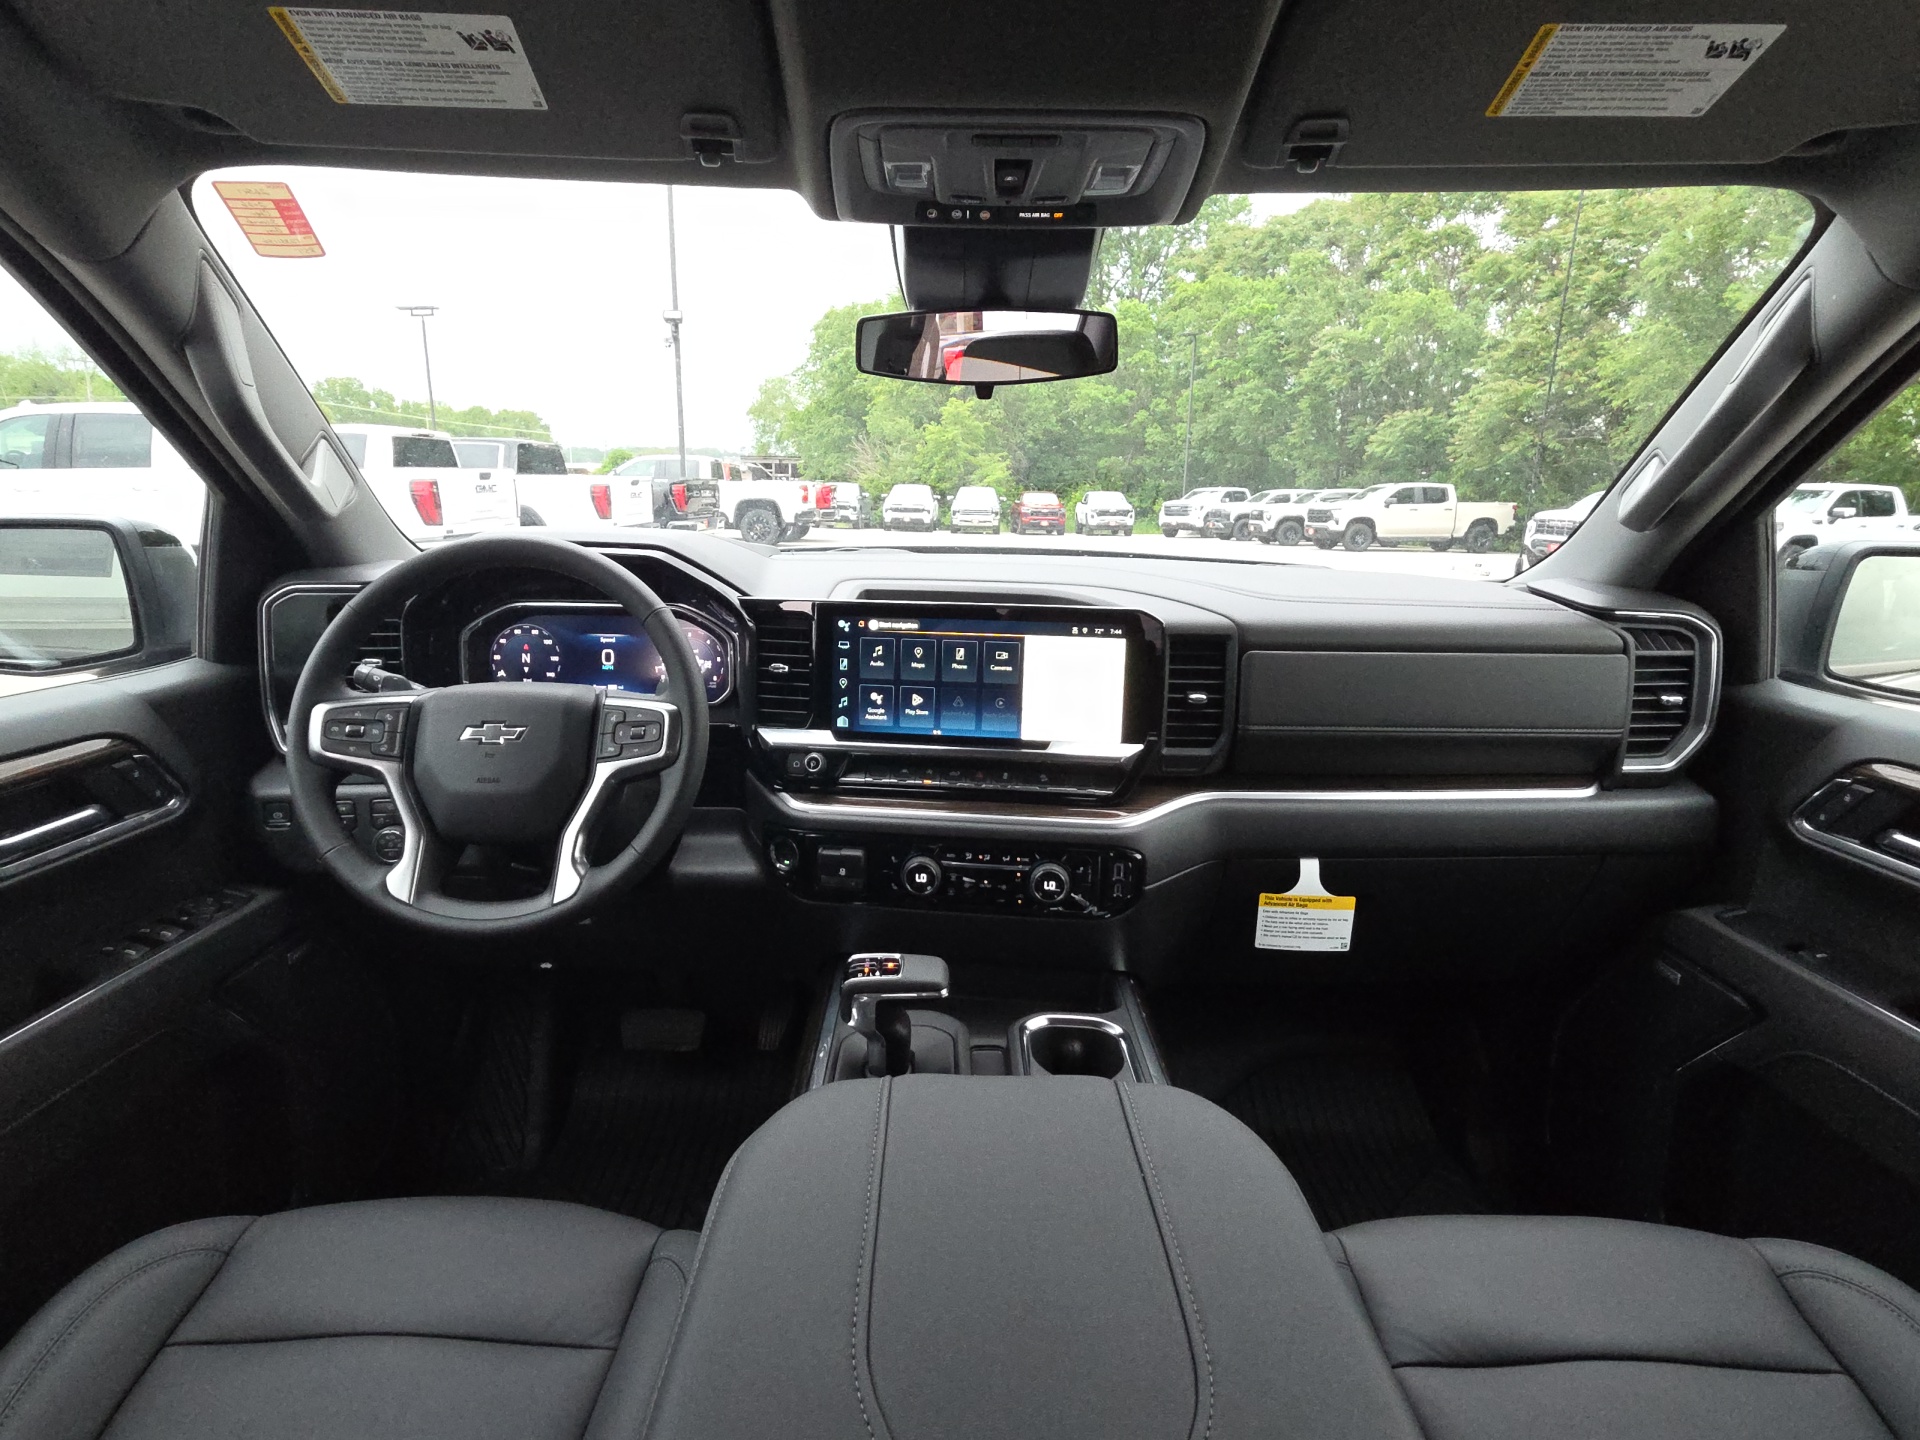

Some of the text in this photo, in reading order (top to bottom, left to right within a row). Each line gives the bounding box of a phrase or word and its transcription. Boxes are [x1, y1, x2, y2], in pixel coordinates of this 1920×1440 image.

[335, 11, 381, 19] ADVANCED
[475, 484, 497, 493] GMC
[522, 652, 531, 664] N
[601, 648, 615, 666] 0
[867, 706, 885, 714] Google
